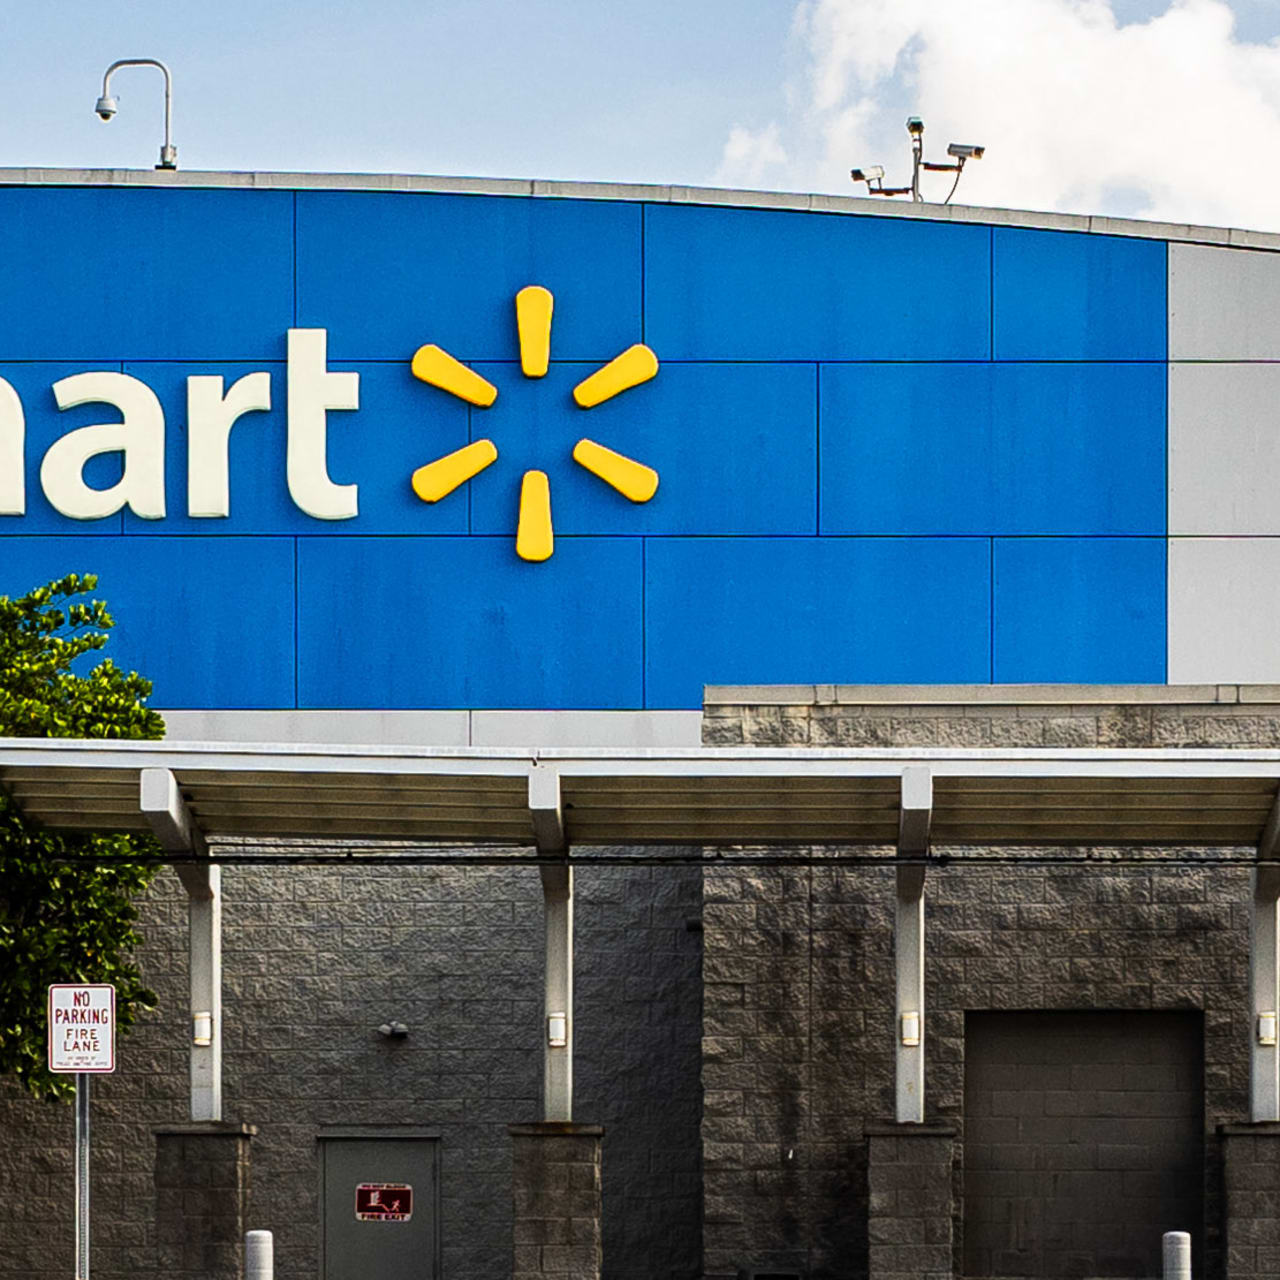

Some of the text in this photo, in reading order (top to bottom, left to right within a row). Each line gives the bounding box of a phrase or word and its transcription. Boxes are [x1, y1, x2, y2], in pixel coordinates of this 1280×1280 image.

[73, 991, 90, 1007] NO
[55, 1008, 109, 1025] PARKING
[66, 1028, 98, 1040] FIRE
[63, 1040, 100, 1052] LANE
